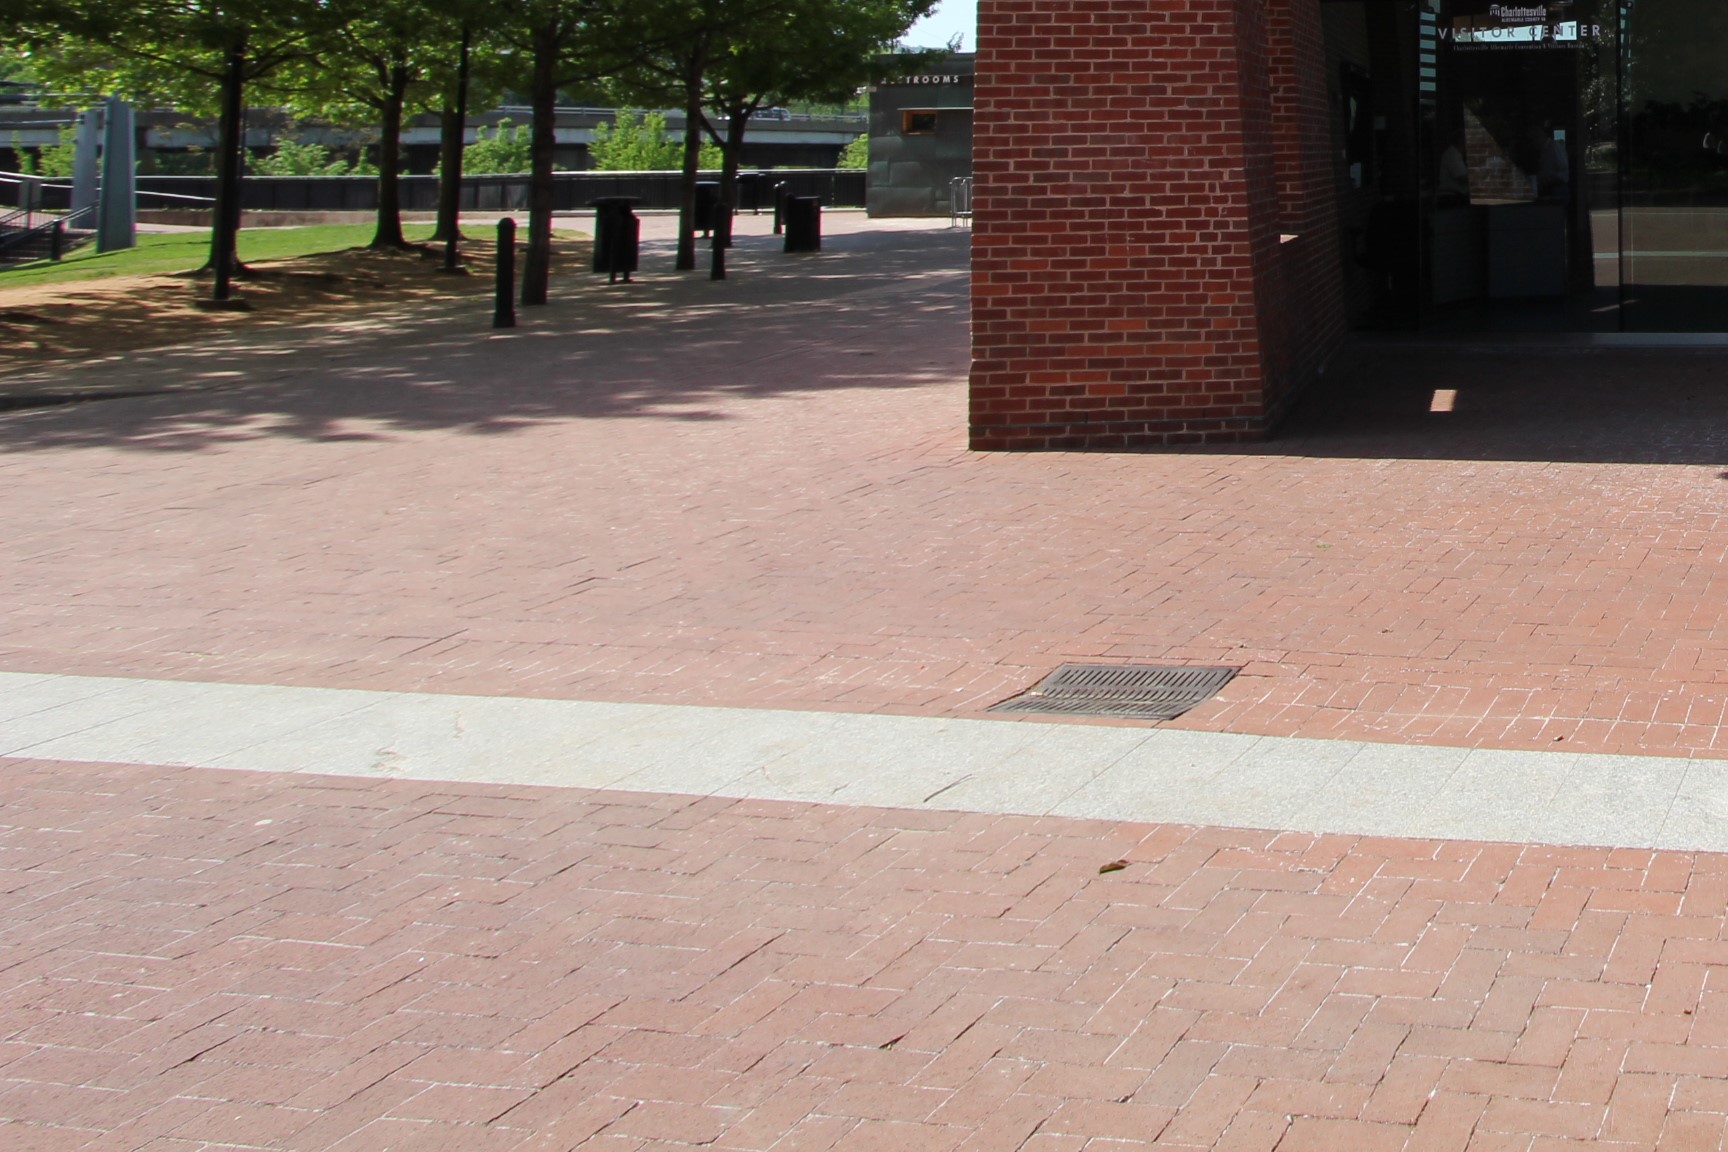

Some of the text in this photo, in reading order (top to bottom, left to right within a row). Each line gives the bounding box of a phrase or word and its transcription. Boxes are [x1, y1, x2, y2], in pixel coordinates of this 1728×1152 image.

[1500, 4, 1547, 17] Charlottesville
[1439, 23, 1600, 40] VISITOR CENTER
